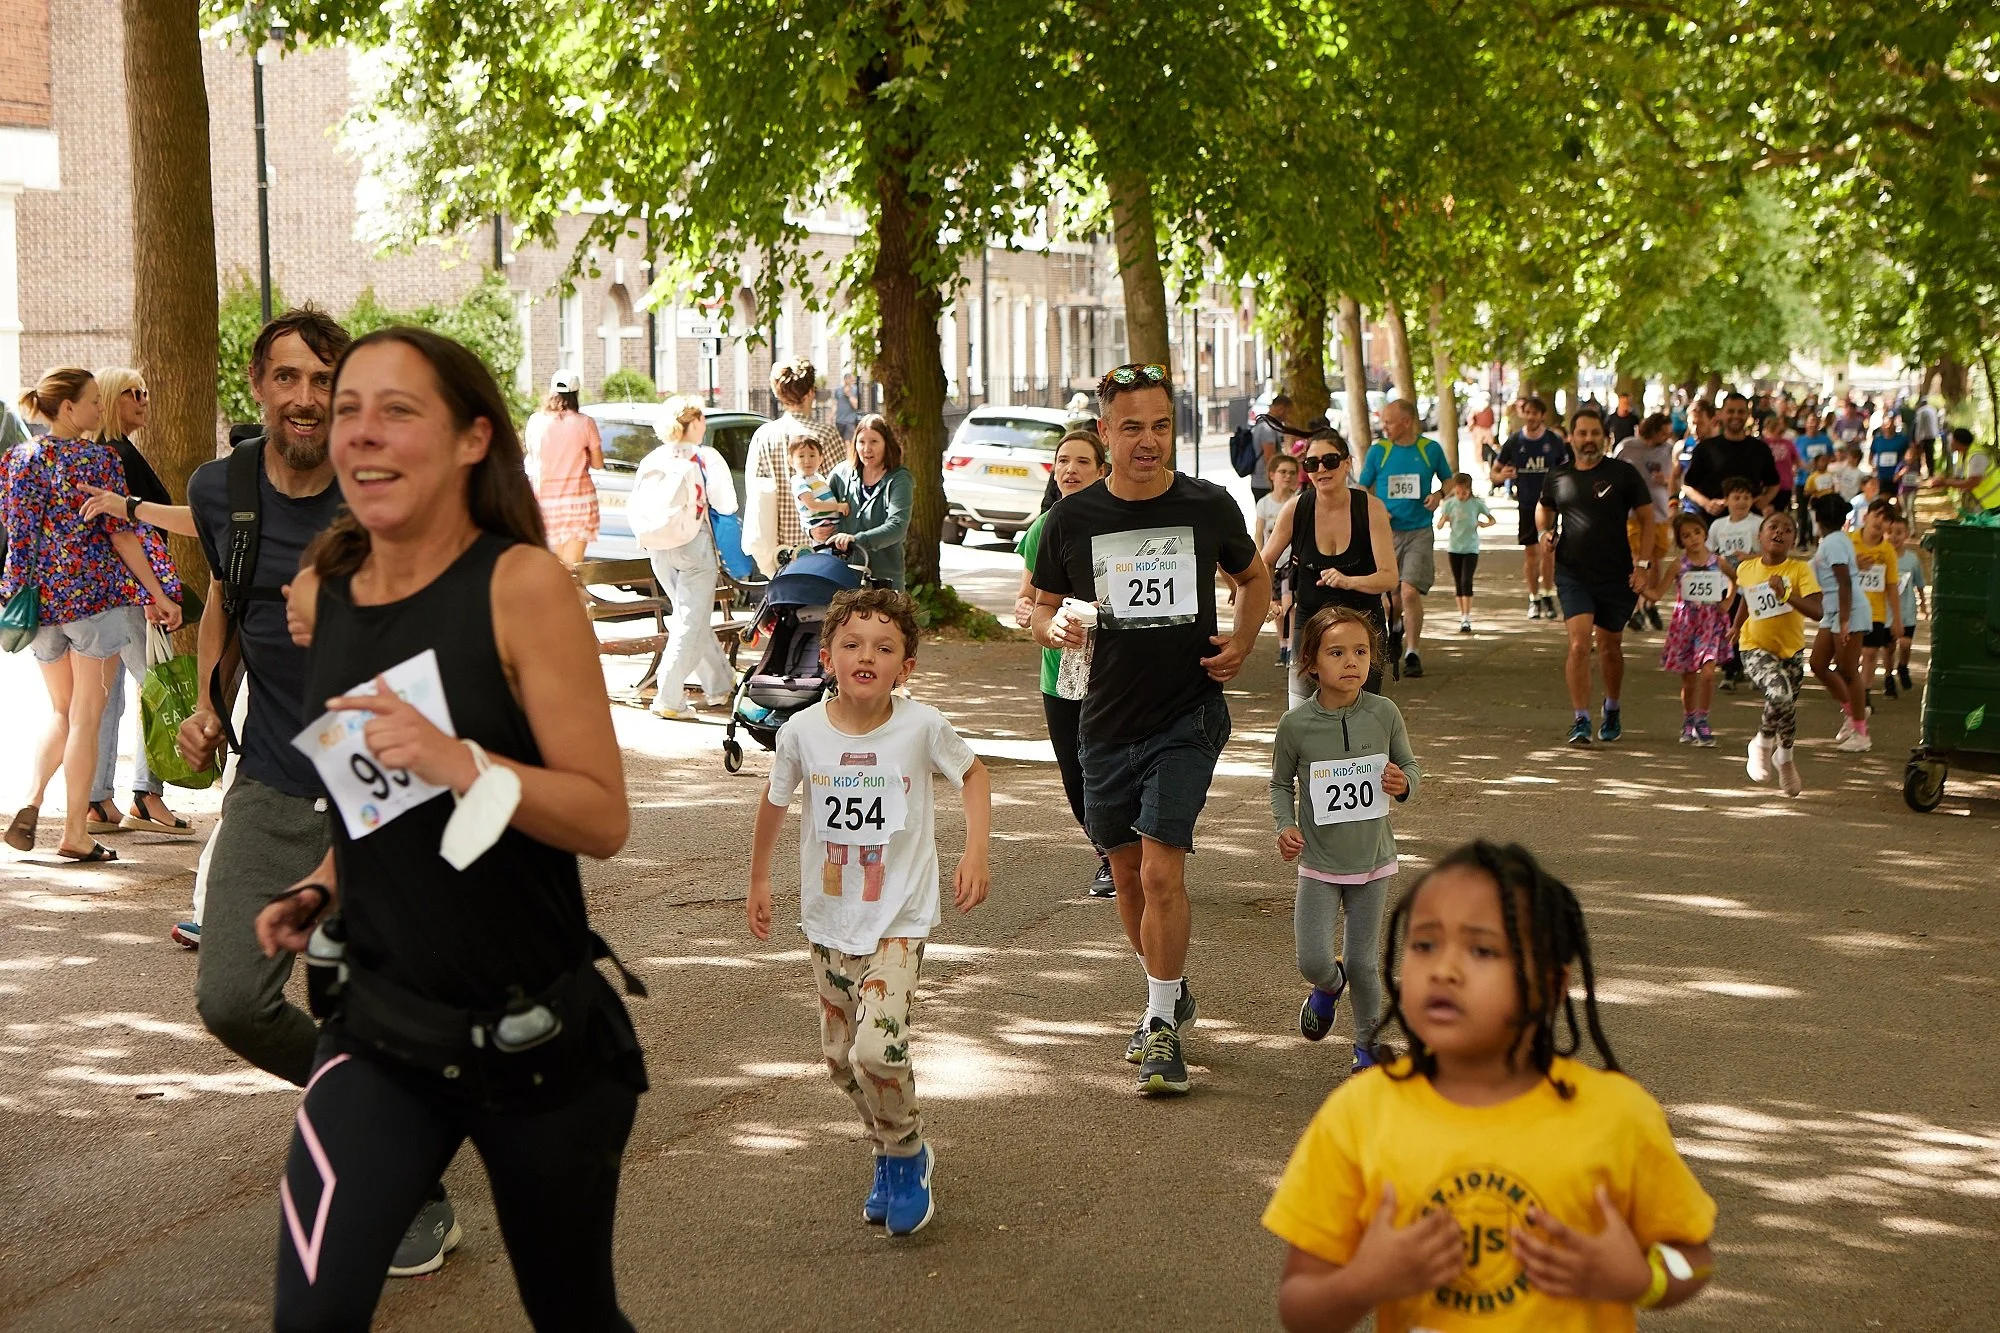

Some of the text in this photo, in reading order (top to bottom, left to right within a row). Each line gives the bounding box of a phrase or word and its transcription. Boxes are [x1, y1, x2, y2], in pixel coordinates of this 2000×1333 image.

[1395, 483, 1413, 494] 369
[1115, 562, 1133, 573] RUN
[1159, 560, 1177, 570] RUN
[1128, 577, 1175, 607] 251
[1689, 582, 1713, 596] 255
[1313, 768, 1331, 779] RUN
[1356, 763, 1372, 775] RUN
[811, 773, 831, 788] RUN
[863, 776, 885, 788] RUN
[1325, 780, 1374, 812] 230
[824, 795, 886, 831] 254
